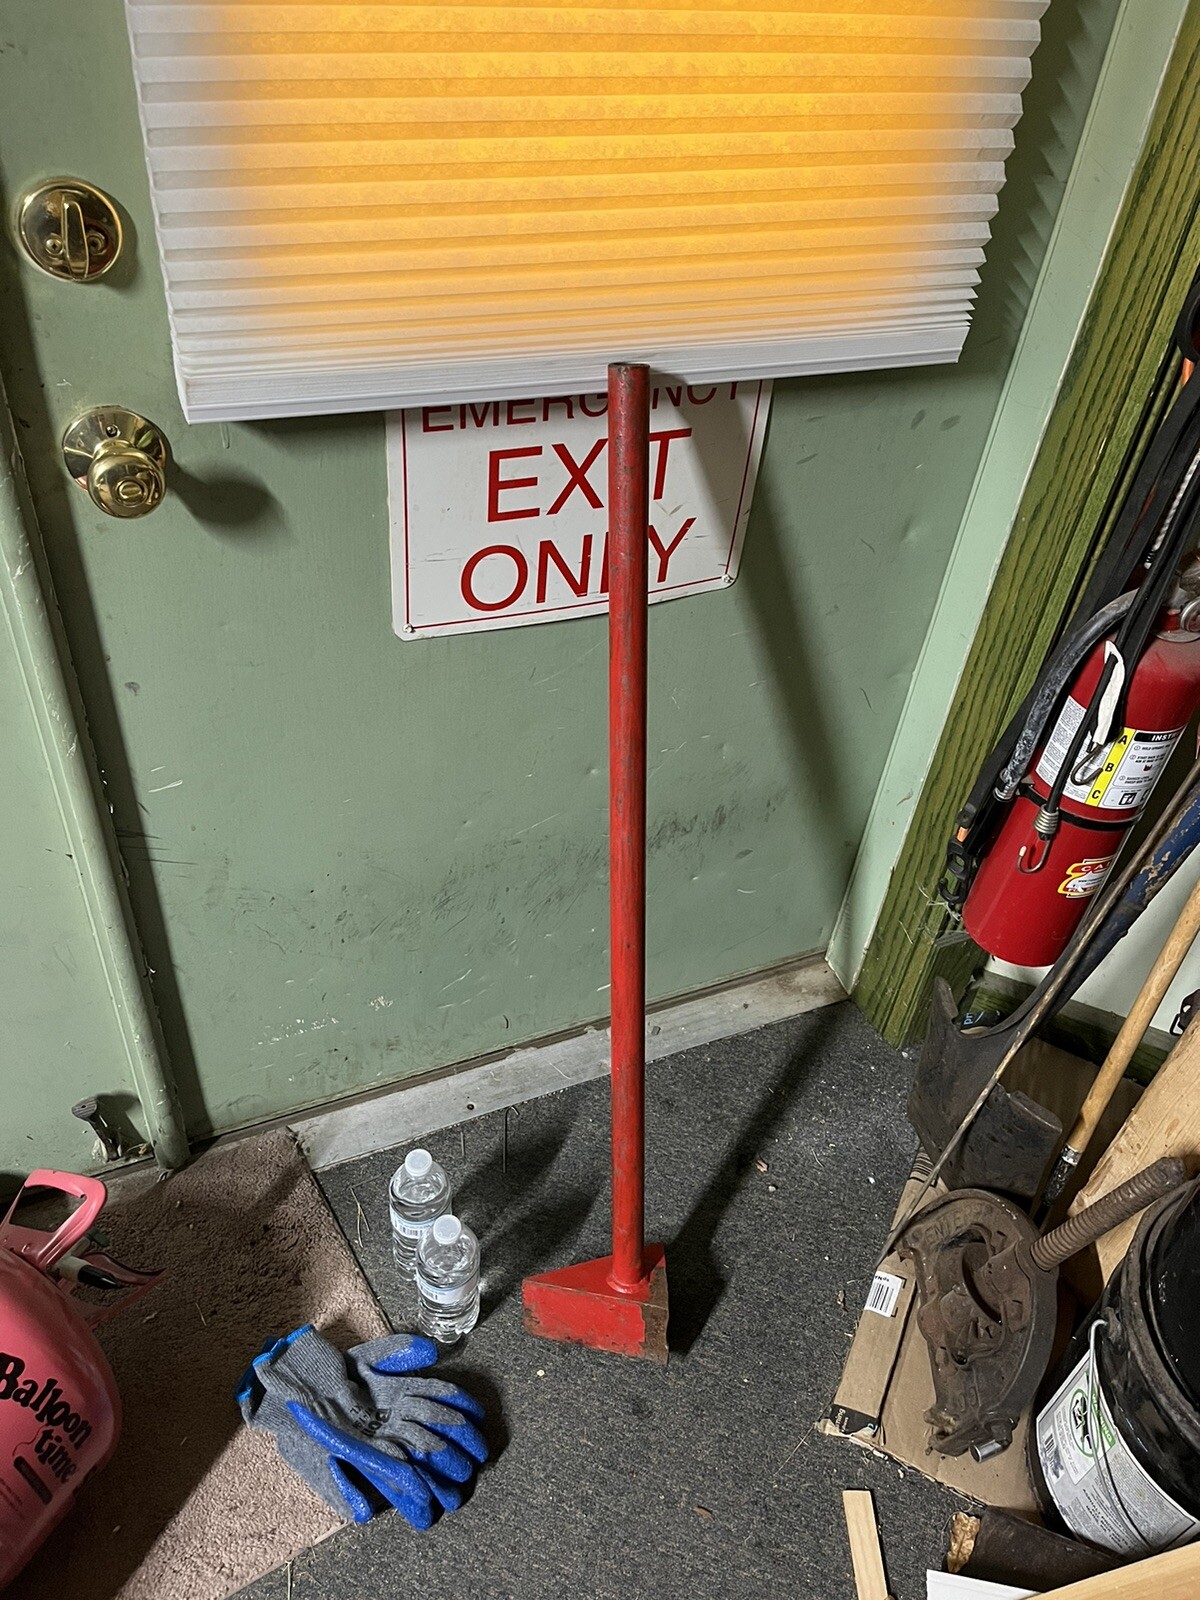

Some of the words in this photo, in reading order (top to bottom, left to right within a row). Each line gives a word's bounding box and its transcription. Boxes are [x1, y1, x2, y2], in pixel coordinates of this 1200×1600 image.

[487, 427, 693, 523] EXT
[1118, 734, 1128, 745] A
[1104, 762, 1114, 772] B
[1091, 789, 1101, 799] C
[34, 1428, 78, 1483] time
